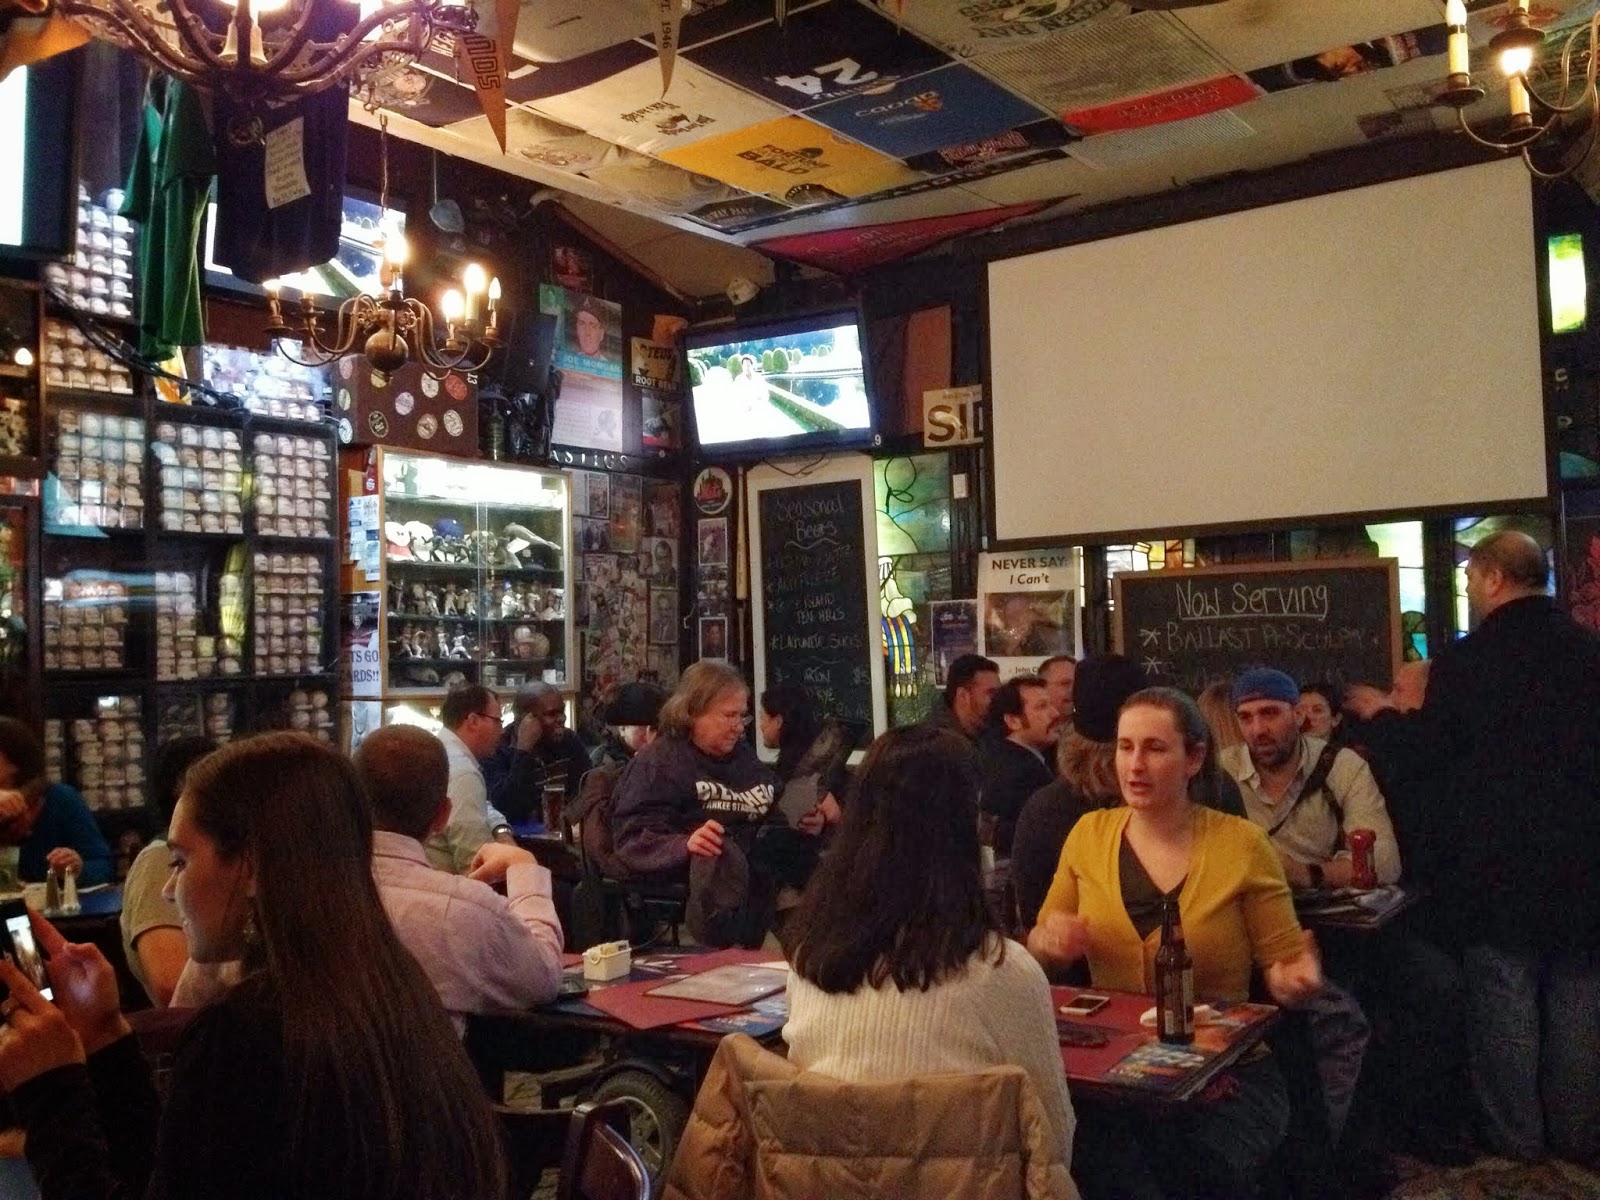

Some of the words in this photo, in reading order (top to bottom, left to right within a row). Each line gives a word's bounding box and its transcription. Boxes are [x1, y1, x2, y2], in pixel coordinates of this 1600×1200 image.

[661, 20, 672, 49] 1946
[775, 57, 878, 96] 24
[635, 375, 656, 386] ROOT
[992, 557, 1036, 570] NEVER
[1017, 573, 1050, 585] Can't
[1176, 579, 1220, 618] Now
[1232, 582, 1328, 622] Serving
[365, 649, 379, 663] GO
